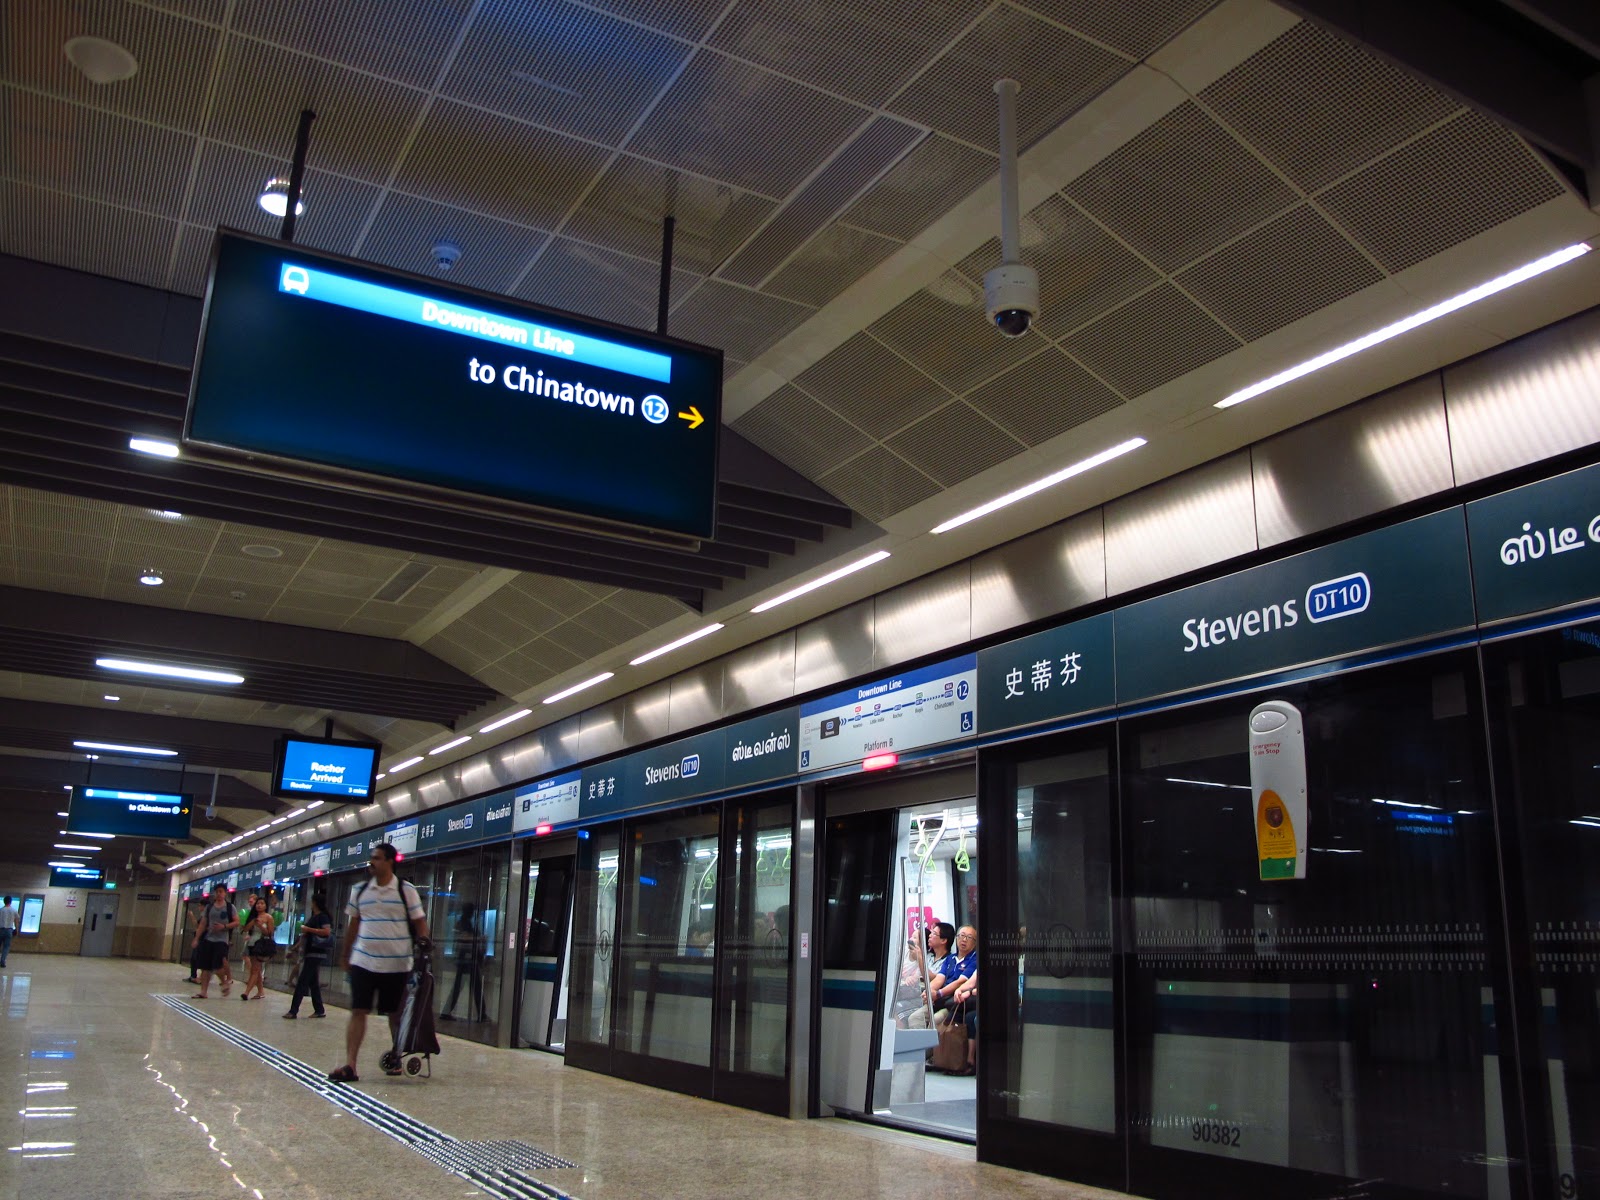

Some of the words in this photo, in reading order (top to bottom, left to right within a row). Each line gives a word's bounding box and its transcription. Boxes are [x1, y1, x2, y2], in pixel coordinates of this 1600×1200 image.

[422, 301, 527, 344] Downtown
[533, 328, 575, 355] Line
[469, 358, 496, 384] to
[503, 365, 635, 416] Chinatown
[645, 400, 665, 419] 12
[1183, 600, 1298, 652] Stevens
[1315, 583, 1361, 613] DT10
[1005, 652, 1082, 700] 史蒂芬
[858, 684, 888, 699] Downtown
[889, 680, 903, 690] Line
[958, 684, 968, 698] 12
[934, 701, 954, 710] Chinatown
[732, 728, 790, 761] ஸ்டீவன்ஸ்
[864, 740, 887, 752] Platform
[889, 738, 893, 746] B
[310, 772, 343, 784] Arrived
[311, 762, 346, 774] Rochor
[645, 764, 679, 785] Stevens
[683, 759, 697, 773] DT10
[588, 777, 615, 800] 史蒂芬
[137, 804, 171, 813] Chinatown
[447, 818, 464, 832] Stevens
[1193, 1122, 1240, 1147] 90382
